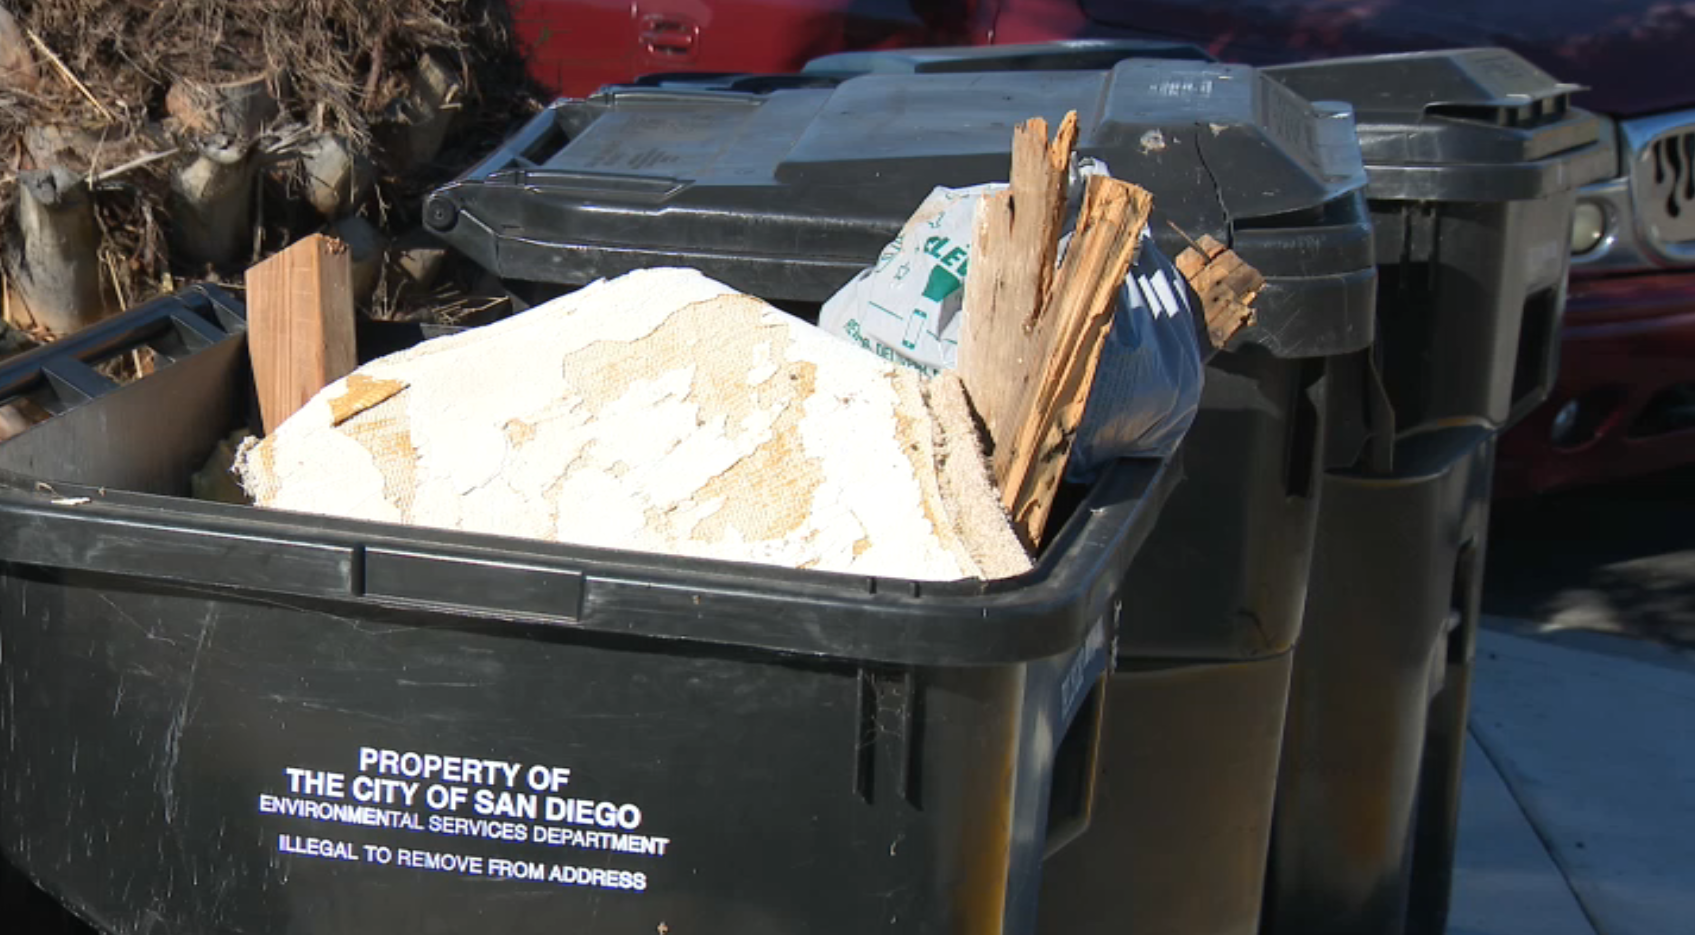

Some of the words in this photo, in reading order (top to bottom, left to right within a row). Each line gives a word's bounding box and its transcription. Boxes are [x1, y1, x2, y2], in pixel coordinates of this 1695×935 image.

[285, 766, 345, 799] THE
[351, 775, 421, 806] CITY
[426, 783, 469, 812] OF
[473, 788, 538, 820] SAN
[545, 796, 642, 830] DIEGO
[359, 746, 522, 788] PROPERTY
[527, 764, 571, 793] OF
[259, 793, 425, 831] ENVIRONMENTAL
[428, 814, 528, 841] SERVICES
[533, 824, 671, 856] DEPARTMENT
[279, 833, 360, 861] ILLEGAL
[362, 844, 393, 864] TO
[397, 848, 483, 875] REMOVE
[488, 858, 545, 881] FROM
[547, 864, 647, 891] ADDRESS
